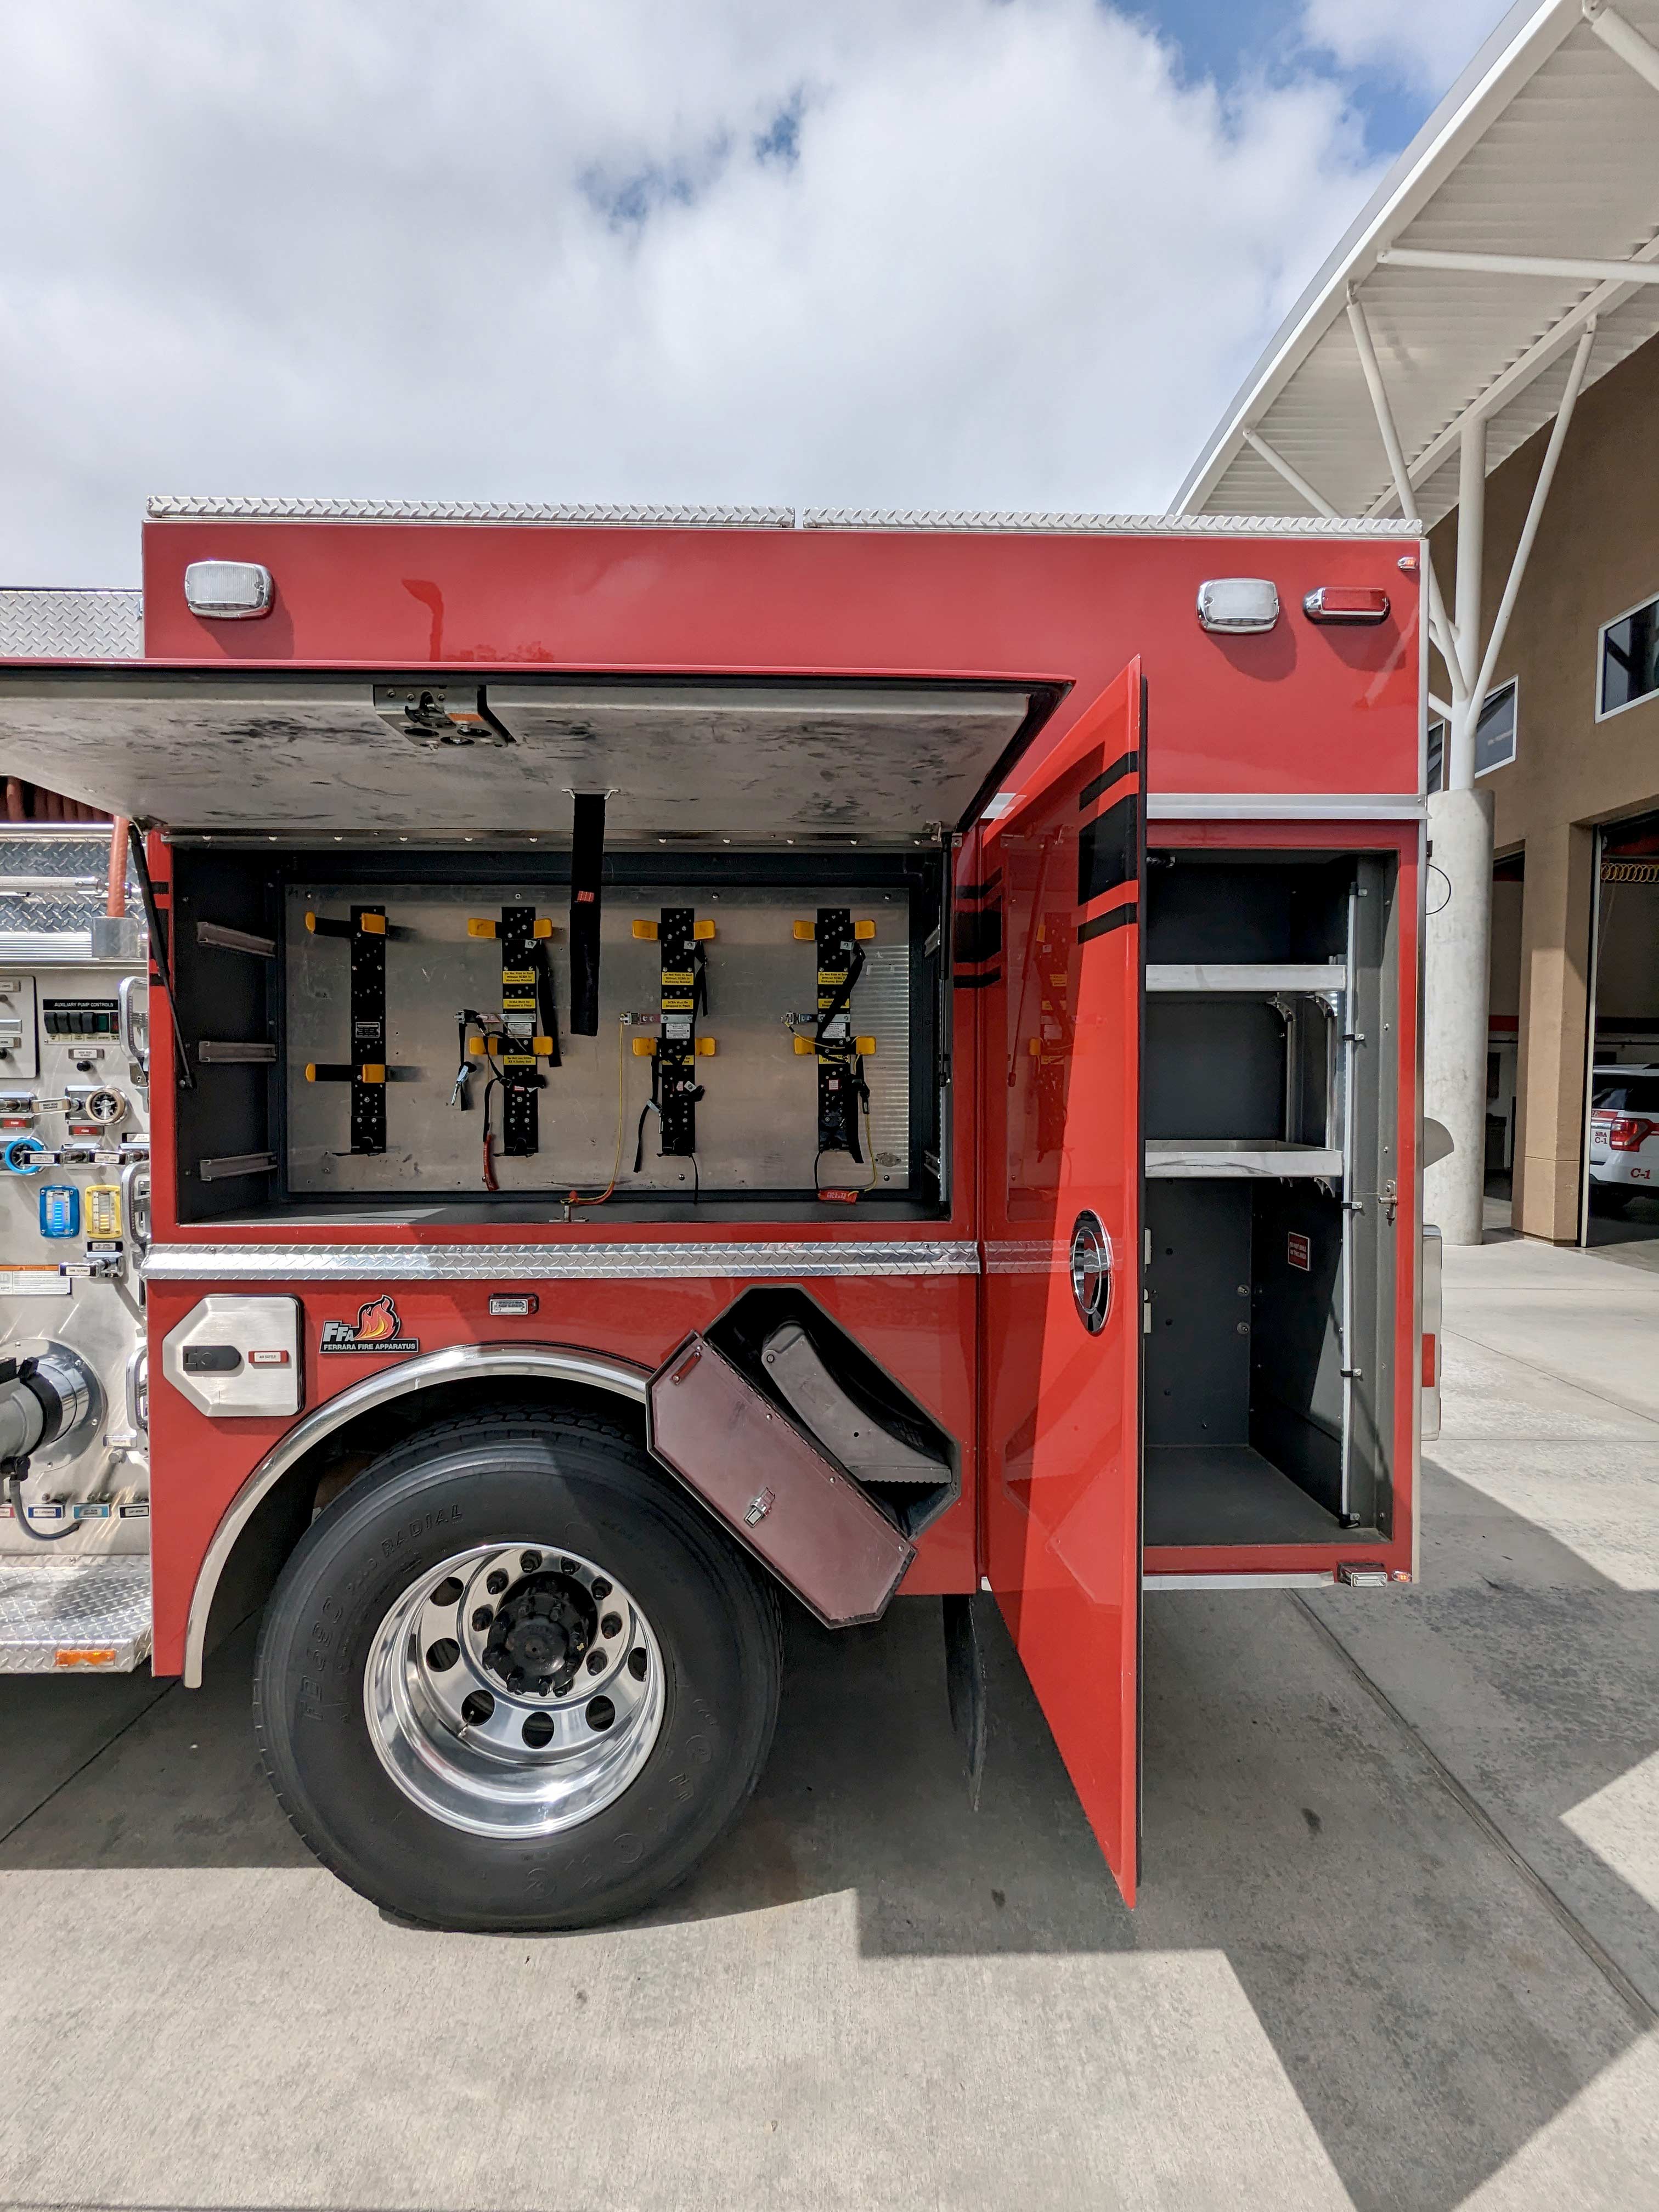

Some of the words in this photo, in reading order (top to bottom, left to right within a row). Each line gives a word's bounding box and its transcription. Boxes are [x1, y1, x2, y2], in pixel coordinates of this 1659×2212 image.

[1630, 1168, 1651, 1180] C-1
[323, 1323, 354, 1342] FFA
[381, 1504, 464, 1558] RADIAL
